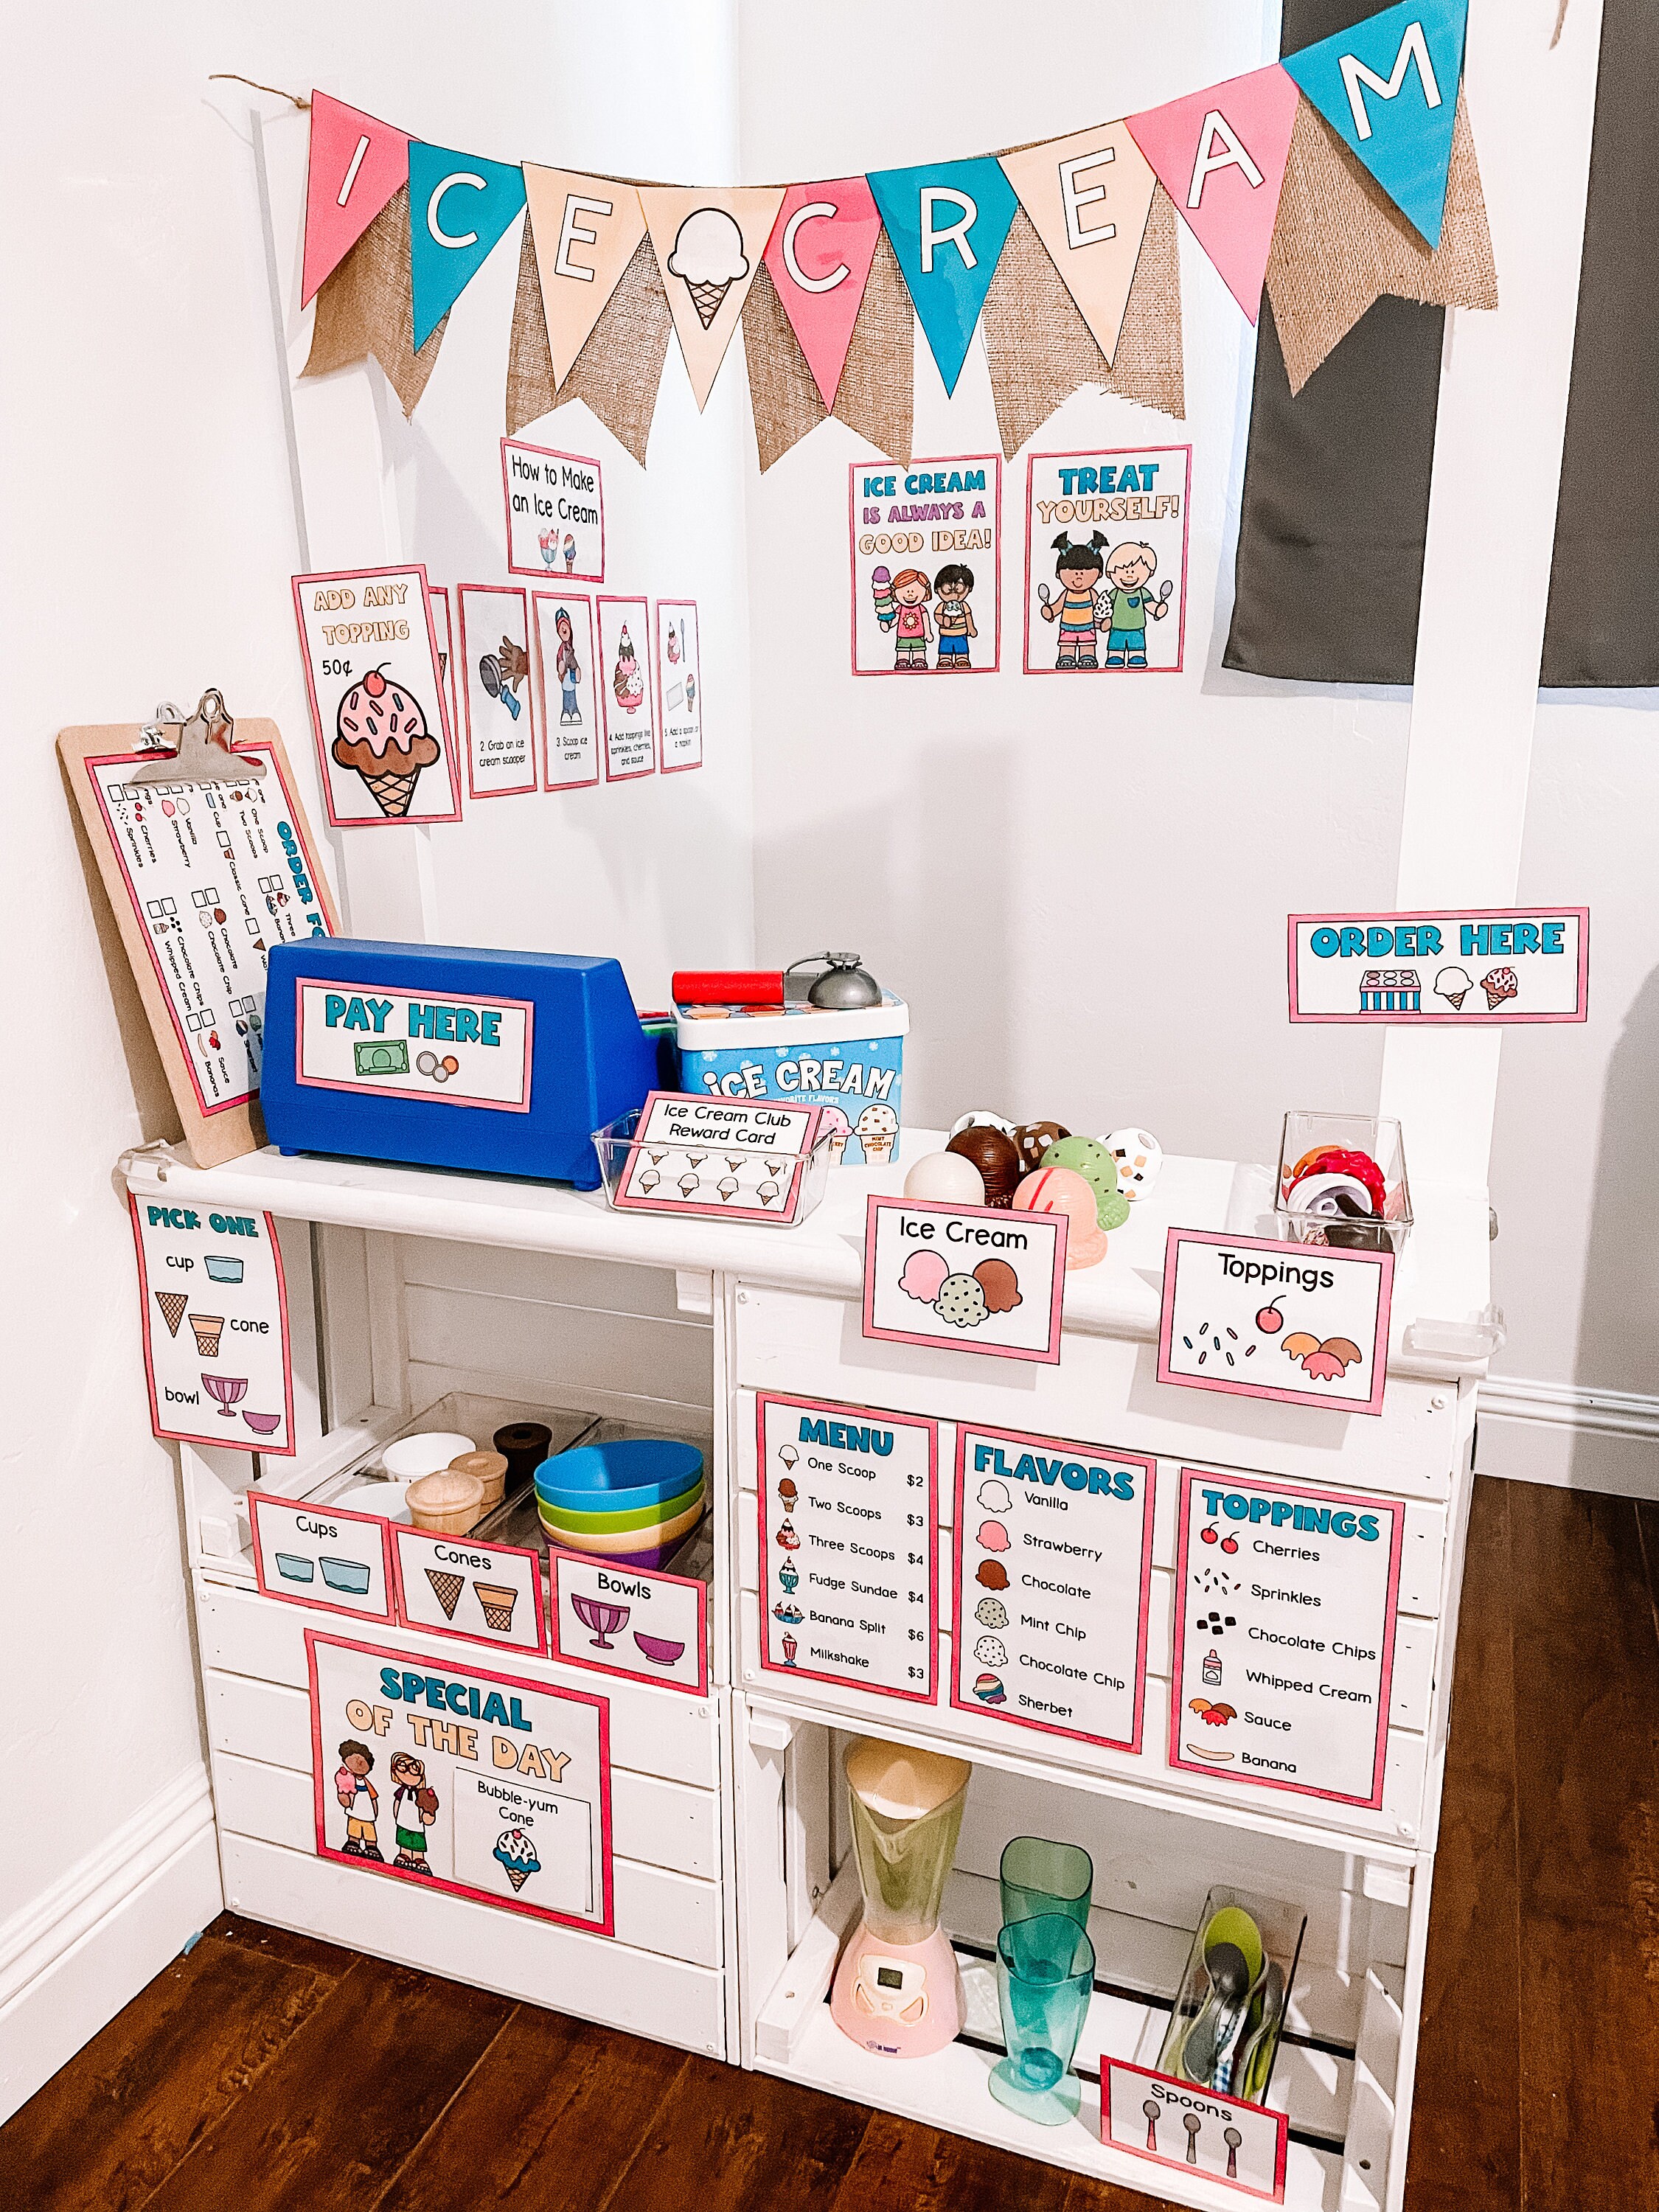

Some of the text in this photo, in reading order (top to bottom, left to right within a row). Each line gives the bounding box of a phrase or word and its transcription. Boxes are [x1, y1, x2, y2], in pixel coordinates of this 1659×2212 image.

[512, 454, 594, 493] How to Make
[863, 470, 986, 498] ICE CREAM
[1058, 463, 1159, 495] TREAT
[512, 493, 598, 525] an Ice Cream
[863, 501, 986, 524] IS ALWAYS A
[1037, 495, 1180, 524] YOURSELF!
[858, 529, 991, 555] GOOD IDEA!
[314, 584, 408, 611] ADD ANY
[322, 620, 410, 645] TOPPING
[322, 659, 352, 677] 50¢
[488, 740, 504, 751] Grab
[507, 741, 514, 749] an
[516, 740, 524, 748] ice
[563, 737, 578, 746] Scoop
[565, 752, 581, 760] cream
[479, 754, 526, 767] cream scooper
[141, 825, 156, 863] Cherries
[172, 820, 190, 868] Strawberry
[186, 818, 197, 844] Vanilla
[246, 830, 257, 858] Scoops
[258, 829, 268, 853] Scoop
[127, 827, 143, 868] Sprinkles
[229, 861, 249, 916] Classic Cone
[277, 821, 325, 937] ORDER FO
[274, 919, 286, 943] Banan
[285, 913, 295, 936] Three
[220, 928, 237, 969] Chocolate
[1310, 922, 1565, 958] ORDER HERE
[165, 941, 192, 1011] Whipped Cream
[178, 936, 204, 1006] Chocolate Chips
[208, 931, 232, 995] Chocolate Chip
[325, 995, 501, 1047] PAY HERE
[205, 1061, 220, 1097] Bananas
[219, 1057, 230, 1084] Sauce
[775, 1060, 896, 1100] CREAM
[809, 1095, 839, 1103] FLAVORS
[664, 1104, 791, 1127] Ice Cream Club
[669, 1123, 776, 1145] Reward Card
[147, 1206, 259, 1238] PICK ONE
[900, 1216, 1029, 1251] Ice Cream
[166, 1255, 195, 1272] cup
[1217, 1252, 1335, 1293] Toppings
[230, 1318, 270, 1334] cone
[164, 1386, 200, 1405] bowl
[799, 1416, 894, 1457] MENU
[807, 1457, 924, 1488] One Scoop $2
[974, 1444, 1135, 1500] FLAVORS
[808, 1496, 924, 1528] Two Scoops $3
[1024, 1490, 1068, 1511] Vanilla
[296, 1515, 338, 1539] Cups
[1202, 1489, 1380, 1542] TOPPINGS
[434, 1545, 493, 1571] Cones
[808, 1534, 924, 1566] Three Scoops $4
[1023, 1533, 1102, 1562] Strawberry
[1253, 1540, 1321, 1562] Cherries
[597, 1573, 652, 1601] Bowls
[809, 1573, 924, 1605] Fudge Sundae $4
[1021, 1573, 1091, 1599] Chocolate
[1251, 1584, 1321, 1607] Sprinkles
[810, 1610, 925, 1643] Banana Split $6
[1020, 1614, 1087, 1641] Mint Chip
[1248, 1627, 1377, 1661] Chocolate Chips
[810, 1647, 925, 1680] Milkshake $3
[1019, 1654, 1125, 1691] Chocolate Chip
[380, 1667, 532, 1732] SPECIAL
[1245, 1669, 1372, 1705] Whipped Cream
[1018, 1694, 1074, 1718] Sherbet
[1244, 1711, 1292, 1731] Sauce
[346, 1699, 571, 1783] OF THE DAY
[1241, 1752, 1297, 1773] Banana
[478, 1780, 558, 1815] Bubble-yum
[498, 1806, 535, 1827] Cone
[1150, 2082, 1233, 2123] Spoons
